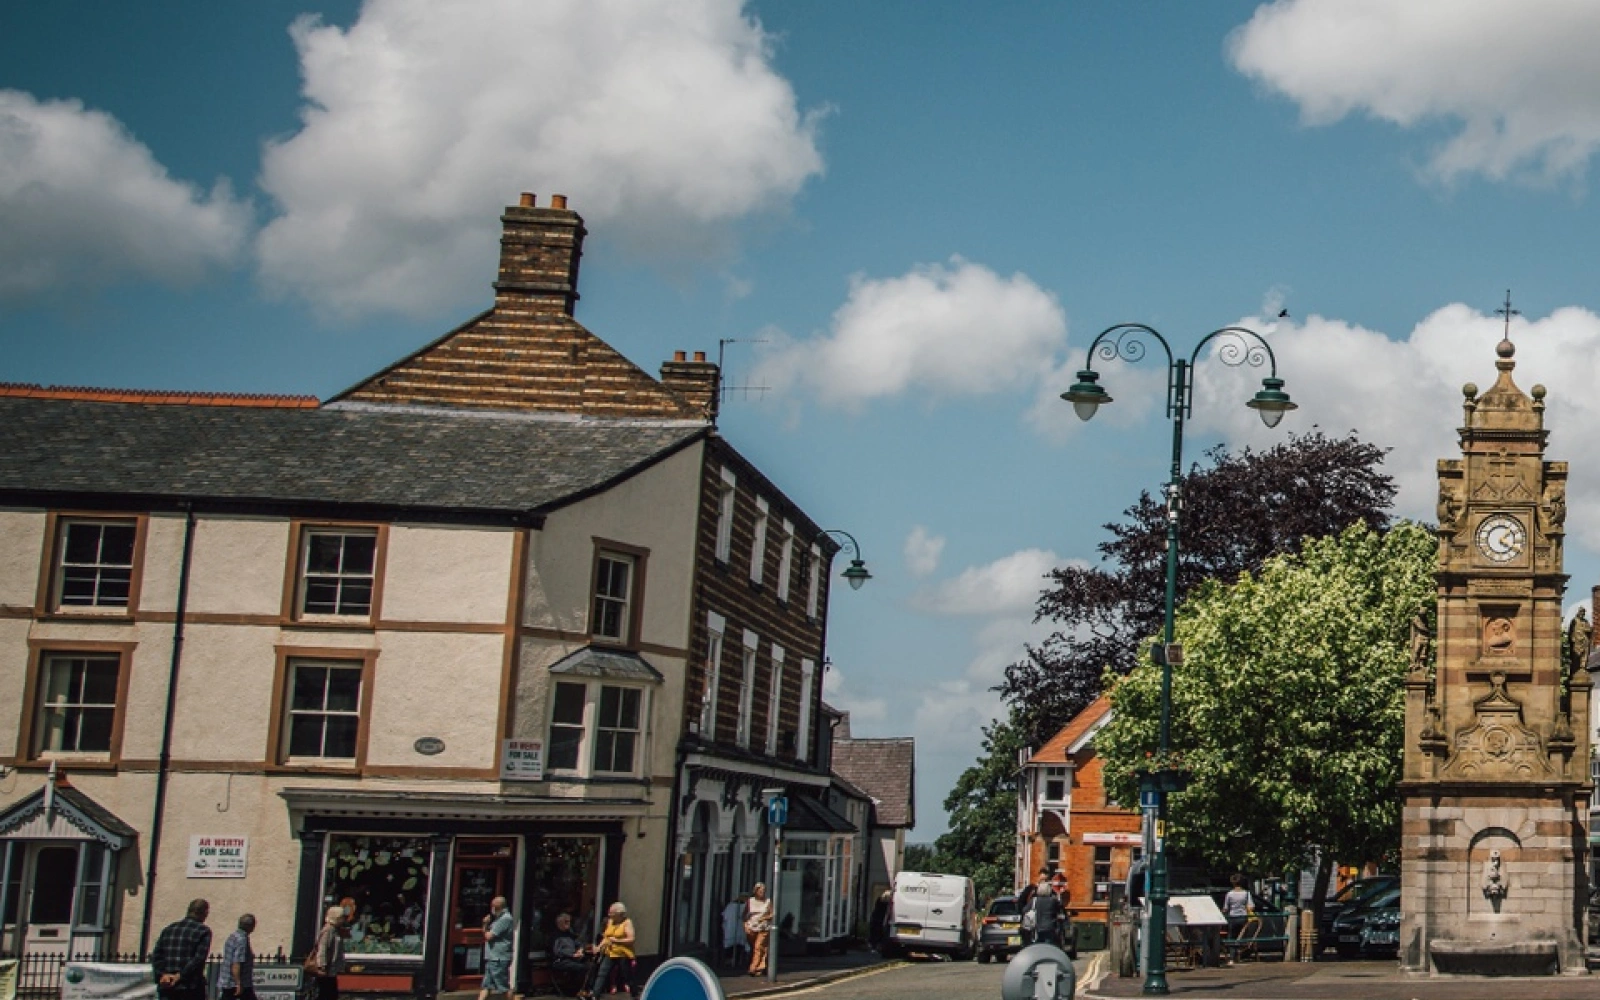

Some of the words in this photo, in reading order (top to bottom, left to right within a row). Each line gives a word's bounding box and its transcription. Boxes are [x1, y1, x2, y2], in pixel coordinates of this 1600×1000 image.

[522, 751, 539, 761] SALE
[199, 847, 217, 856] FOR
[219, 848, 241, 857] SALE
